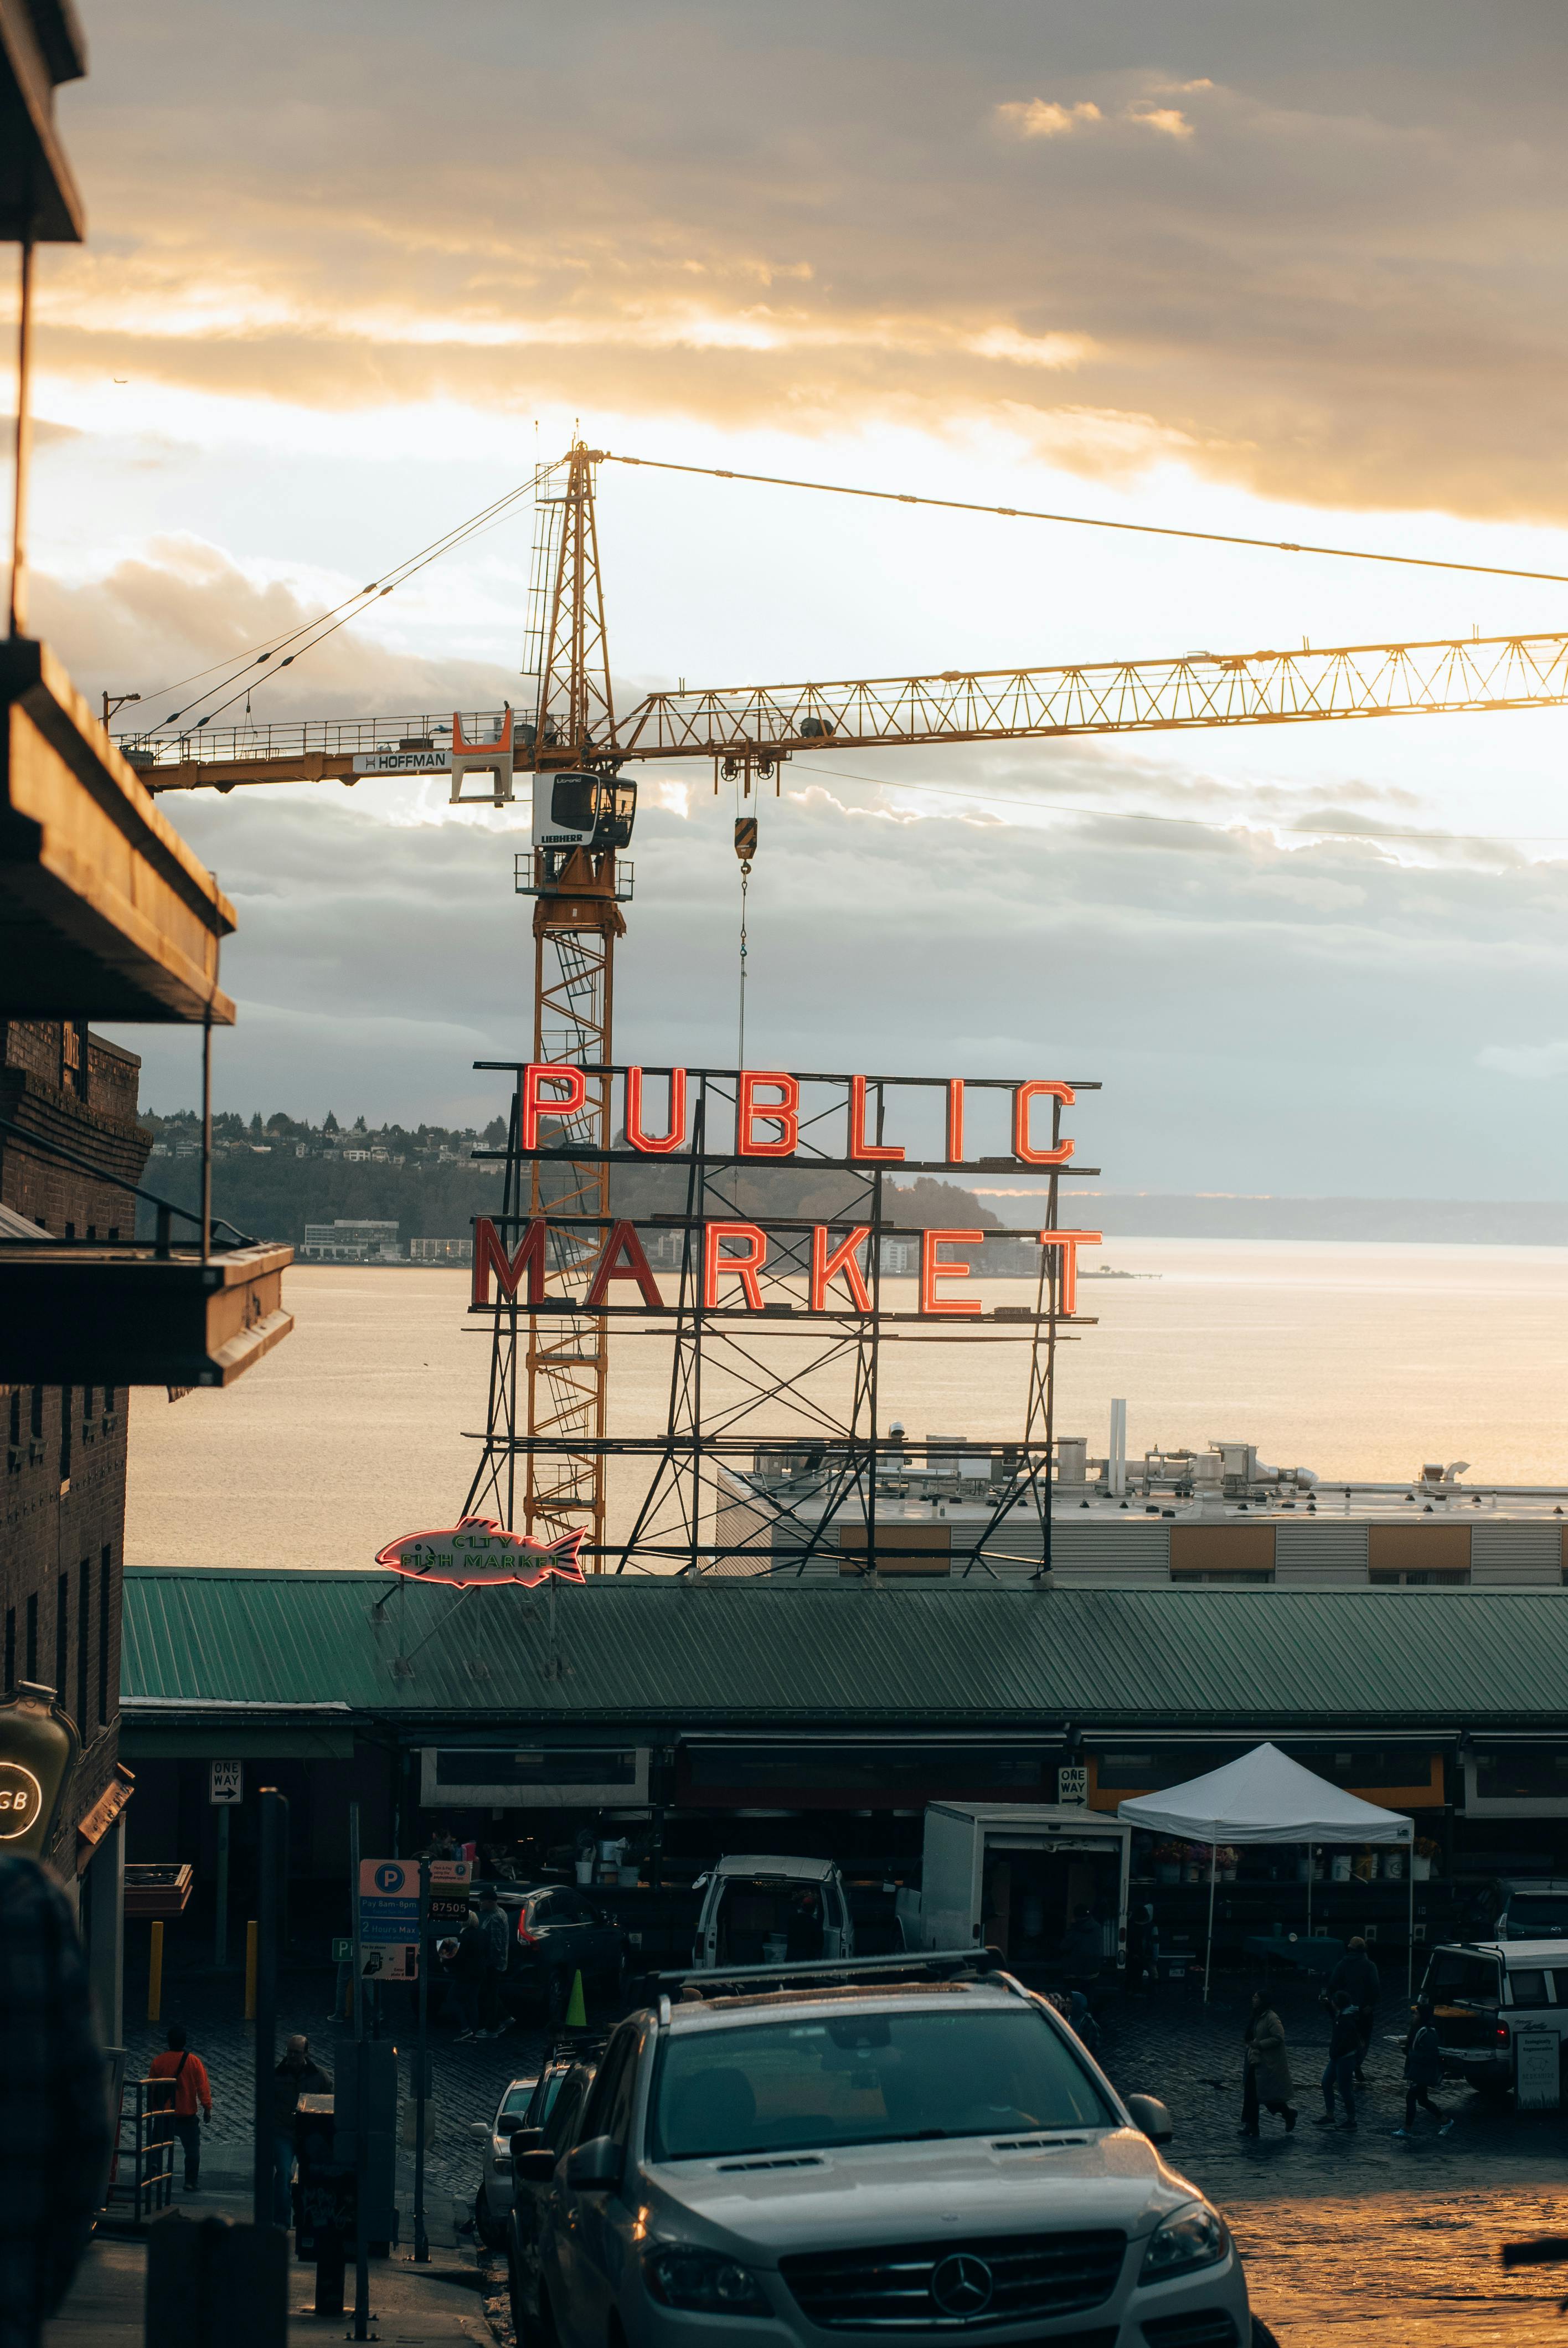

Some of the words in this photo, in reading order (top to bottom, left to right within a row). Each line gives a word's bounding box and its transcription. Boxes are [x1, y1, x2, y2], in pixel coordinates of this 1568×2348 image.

[379, 753, 446, 769] HOFFMAN
[541, 834, 583, 843] LIEBHERR
[520, 1064, 1076, 1165] PUBLIC
[472, 1218, 1103, 1315] MARKET
[452, 1536, 513, 1549] CITY
[400, 1553, 453, 1567] FISH
[464, 1554, 561, 1569] MARKET
[215, 1763, 239, 1773] ONE
[1061, 1769, 1085, 1780] ONE
[214, 1775, 239, 1786] WAY
[1061, 1782, 1086, 1793] WAY
[384, 1870, 399, 1888] P
[362, 1899, 376, 1909] Pay
[378, 1900, 416, 1909] 8am-8pm
[432, 1902, 466, 1913] 87505
[363, 1921, 369, 1932] 2
[339, 1940, 353, 1957] Pi
